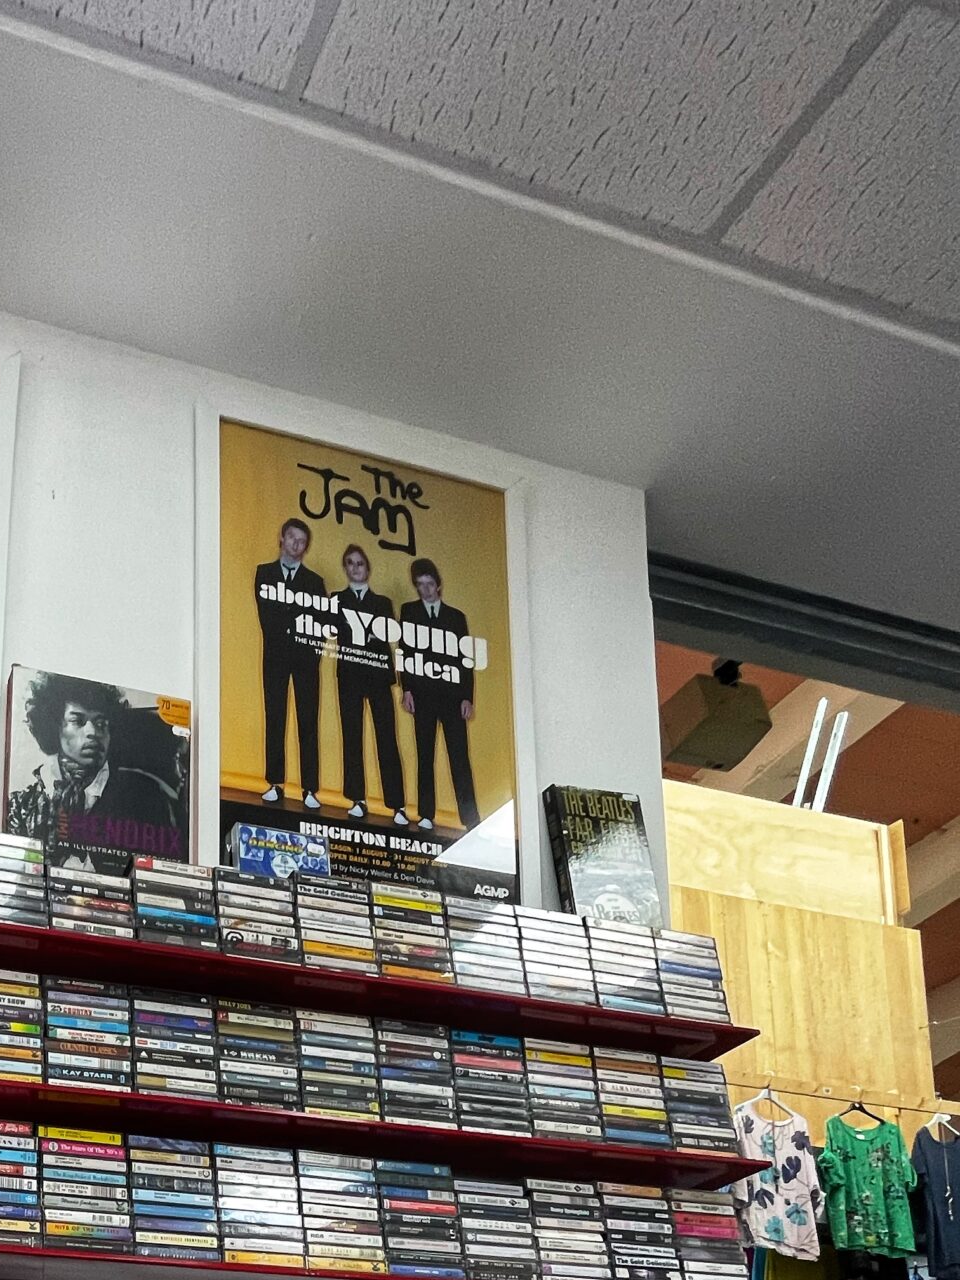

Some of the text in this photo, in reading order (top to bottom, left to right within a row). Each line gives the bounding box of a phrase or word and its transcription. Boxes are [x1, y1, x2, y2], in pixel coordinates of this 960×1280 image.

[360, 464, 430, 510] The
[297, 462, 417, 556] JAM
[259, 581, 340, 615] about
[294, 635, 307, 645] THE
[308, 639, 340, 652] ULTIMATE
[341, 646, 379, 659] EXHIBITION
[295, 607, 489, 672] the Young
[315, 648, 328, 657] THE
[344, 654, 390, 669] MEMORABILIA
[395, 648, 461, 684] idea
[161, 700, 171, 710] 70
[563, 790, 635, 823] THE BEATLES
[70, 814, 182, 853] HENDRIX
[250, 837, 302, 854] DANCING
[299, 821, 443, 857] BRIGHTON BEACH
[73, 843, 128, 857] ILLUSTRATED
[349, 865, 369, 876] Nicky
[370, 868, 392, 879] Weller
[401, 873, 414, 881] Den
[416, 875, 435, 885] Davis
[298, 885, 367, 902] The Gold Collection
[474, 884, 509, 899] AGMP
